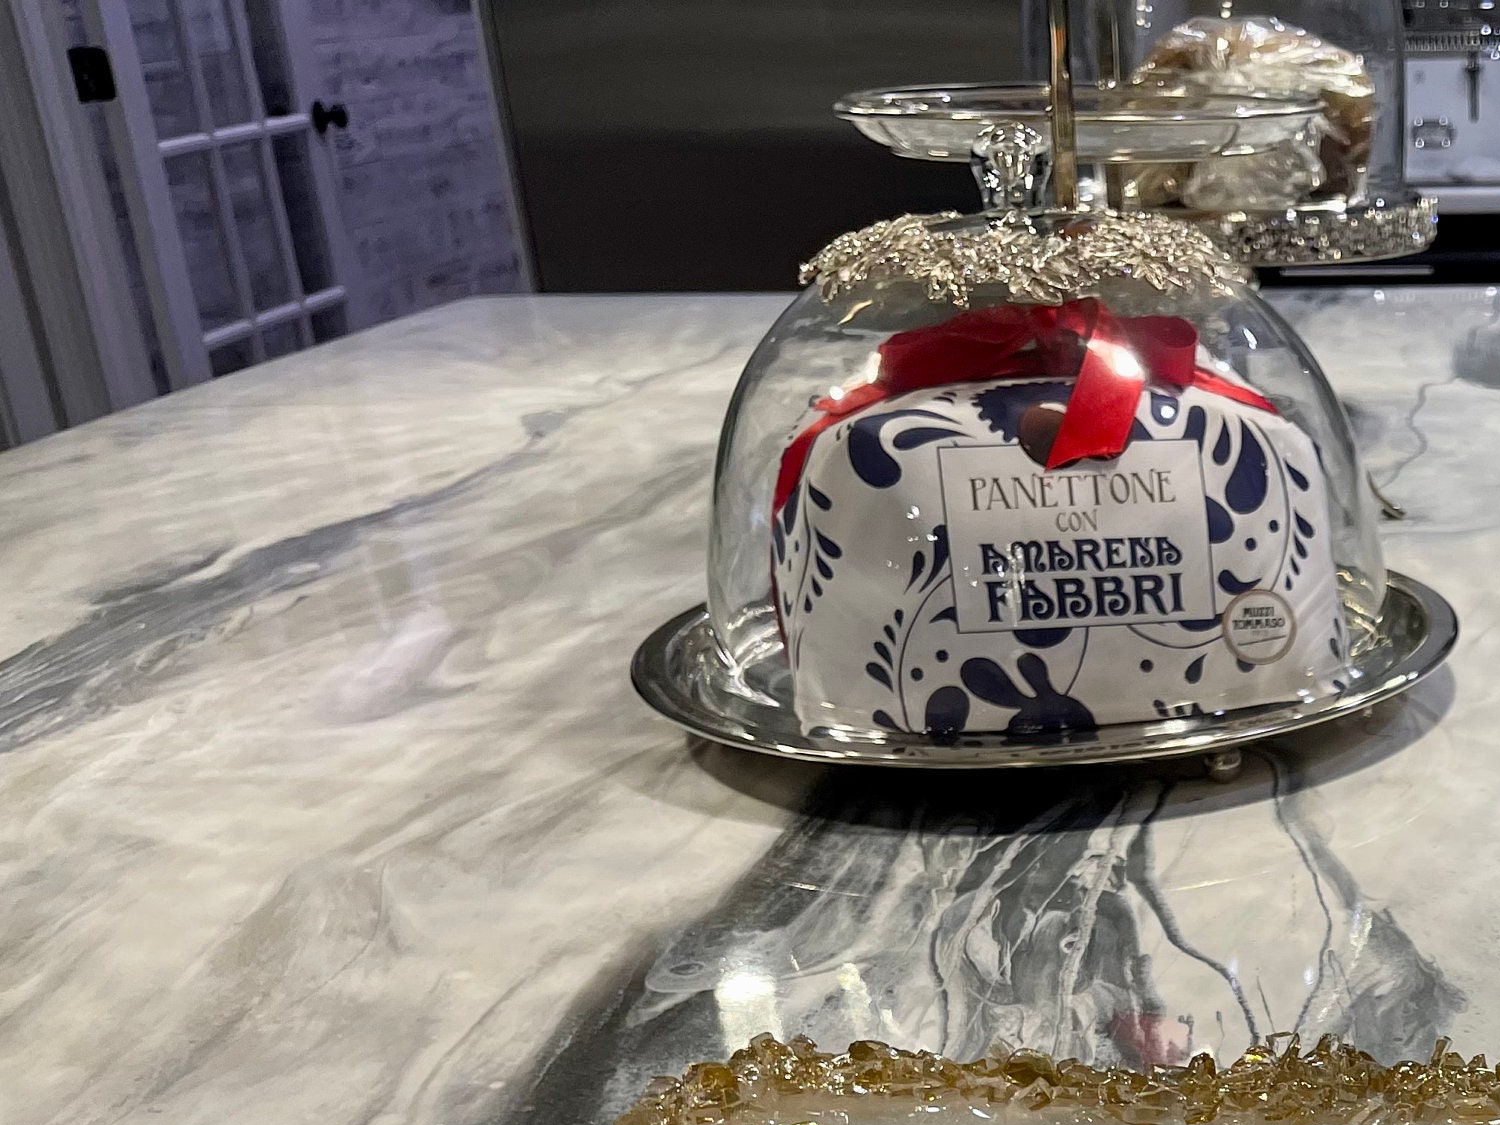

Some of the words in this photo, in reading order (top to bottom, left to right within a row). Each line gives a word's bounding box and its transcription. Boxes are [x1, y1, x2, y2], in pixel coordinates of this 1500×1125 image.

[969, 469, 1177, 511] PANETTONE
[1054, 510, 1099, 532] CON
[981, 536, 1183, 575] AMARENA
[984, 572, 1186, 623] FABBRI
